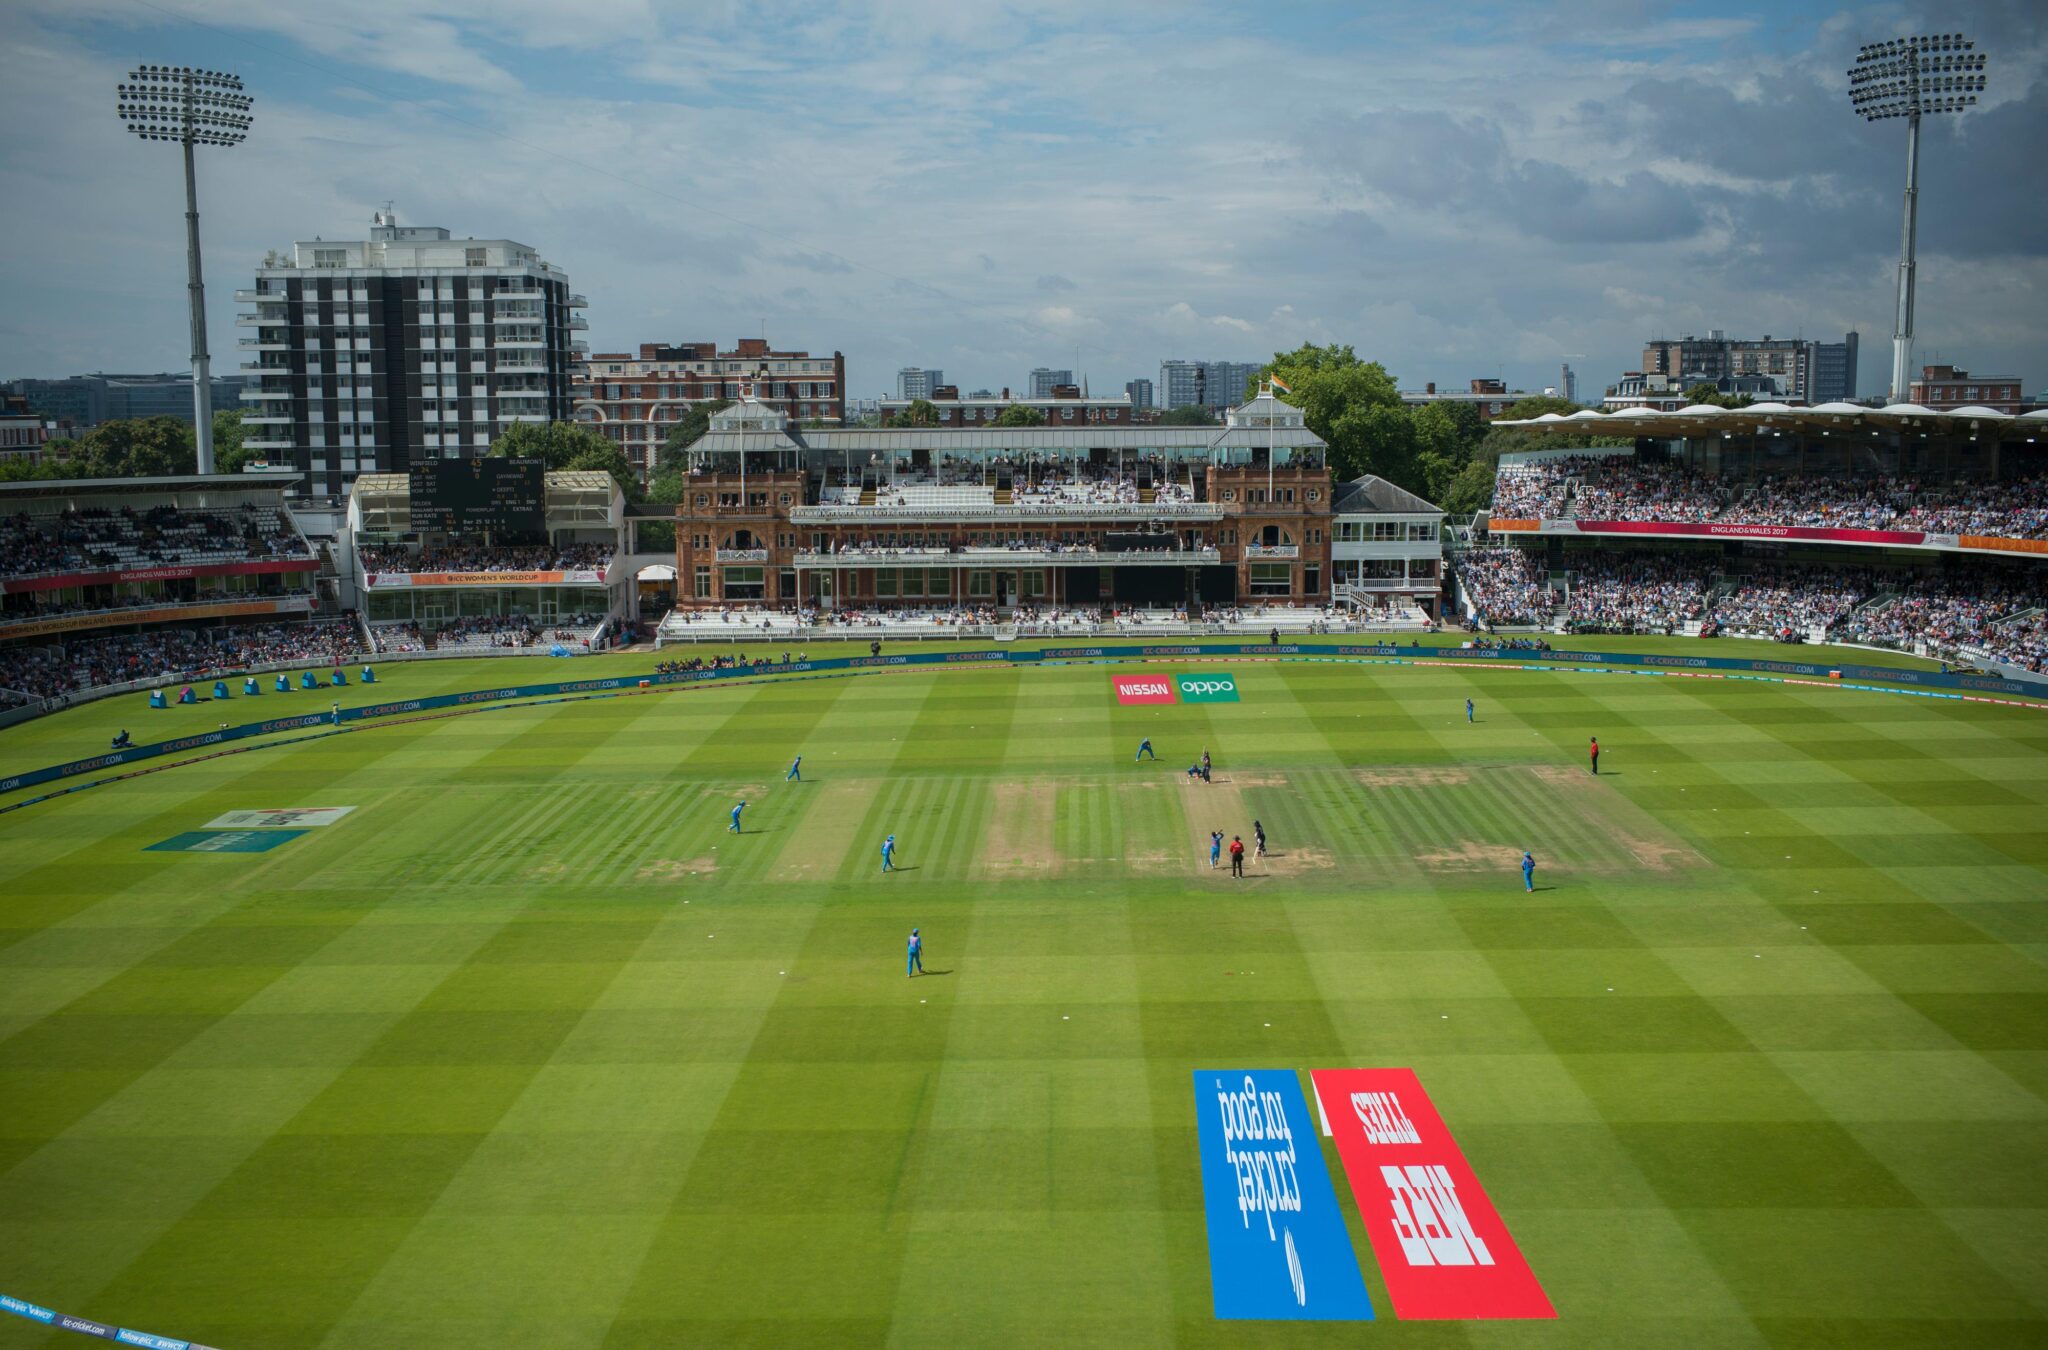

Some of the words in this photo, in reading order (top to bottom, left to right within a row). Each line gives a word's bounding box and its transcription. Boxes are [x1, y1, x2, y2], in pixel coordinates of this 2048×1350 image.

[946, 652, 1004, 661] ICC-CRICKET.COM
[1045, 648, 1102, 657] ICC-CRICKET.COM
[1143, 646, 1200, 655] ICC-CRICKET.COM
[1240, 646, 1299, 654] ICC-CRICKET.COM
[1338, 646, 1397, 655] ICC-CRICKET.COM
[1438, 649, 1498, 658] ICC-CRICKET.COM
[850, 656, 907, 666] ICC-CRICKET.COM
[1540, 652, 1601, 662] ICC-CRICKET.COM
[1643, 656, 1708, 667] ICC-CRICKET.COM
[753, 663, 811, 674] ICC-CRICKET.COM
[1752, 661, 1815, 675] ICC-CRICKET.COM
[659, 671, 716, 682] ICC-CRICKET.COM
[1859, 668, 1918, 682] ICC-CRICKET.COM
[559, 680, 619, 692] ICC-CRICKET.COM
[1119, 683, 1169, 696] NISSAN
[1961, 679, 2024, 693] ICC-CRICKET.COM
[459, 689, 517, 702] ICC-CRICKET.COM
[362, 702, 420, 716] ICC-CRICKET.COM
[262, 716, 321, 731] ICC-CRICKET.COM
[162, 733, 222, 753] ICC-CRICKET.COM
[62, 754, 123, 777] ICC-CRICKET.COM
[1218, 1076, 1264, 1164] good
[1350, 1091, 1423, 1145] TYRES
[1262, 1091, 1296, 1164] for
[1230, 1150, 1302, 1241] cricket
[1380, 1165, 1496, 1266] MRF
[62, 1316, 106, 1336] icc-cricket.com
